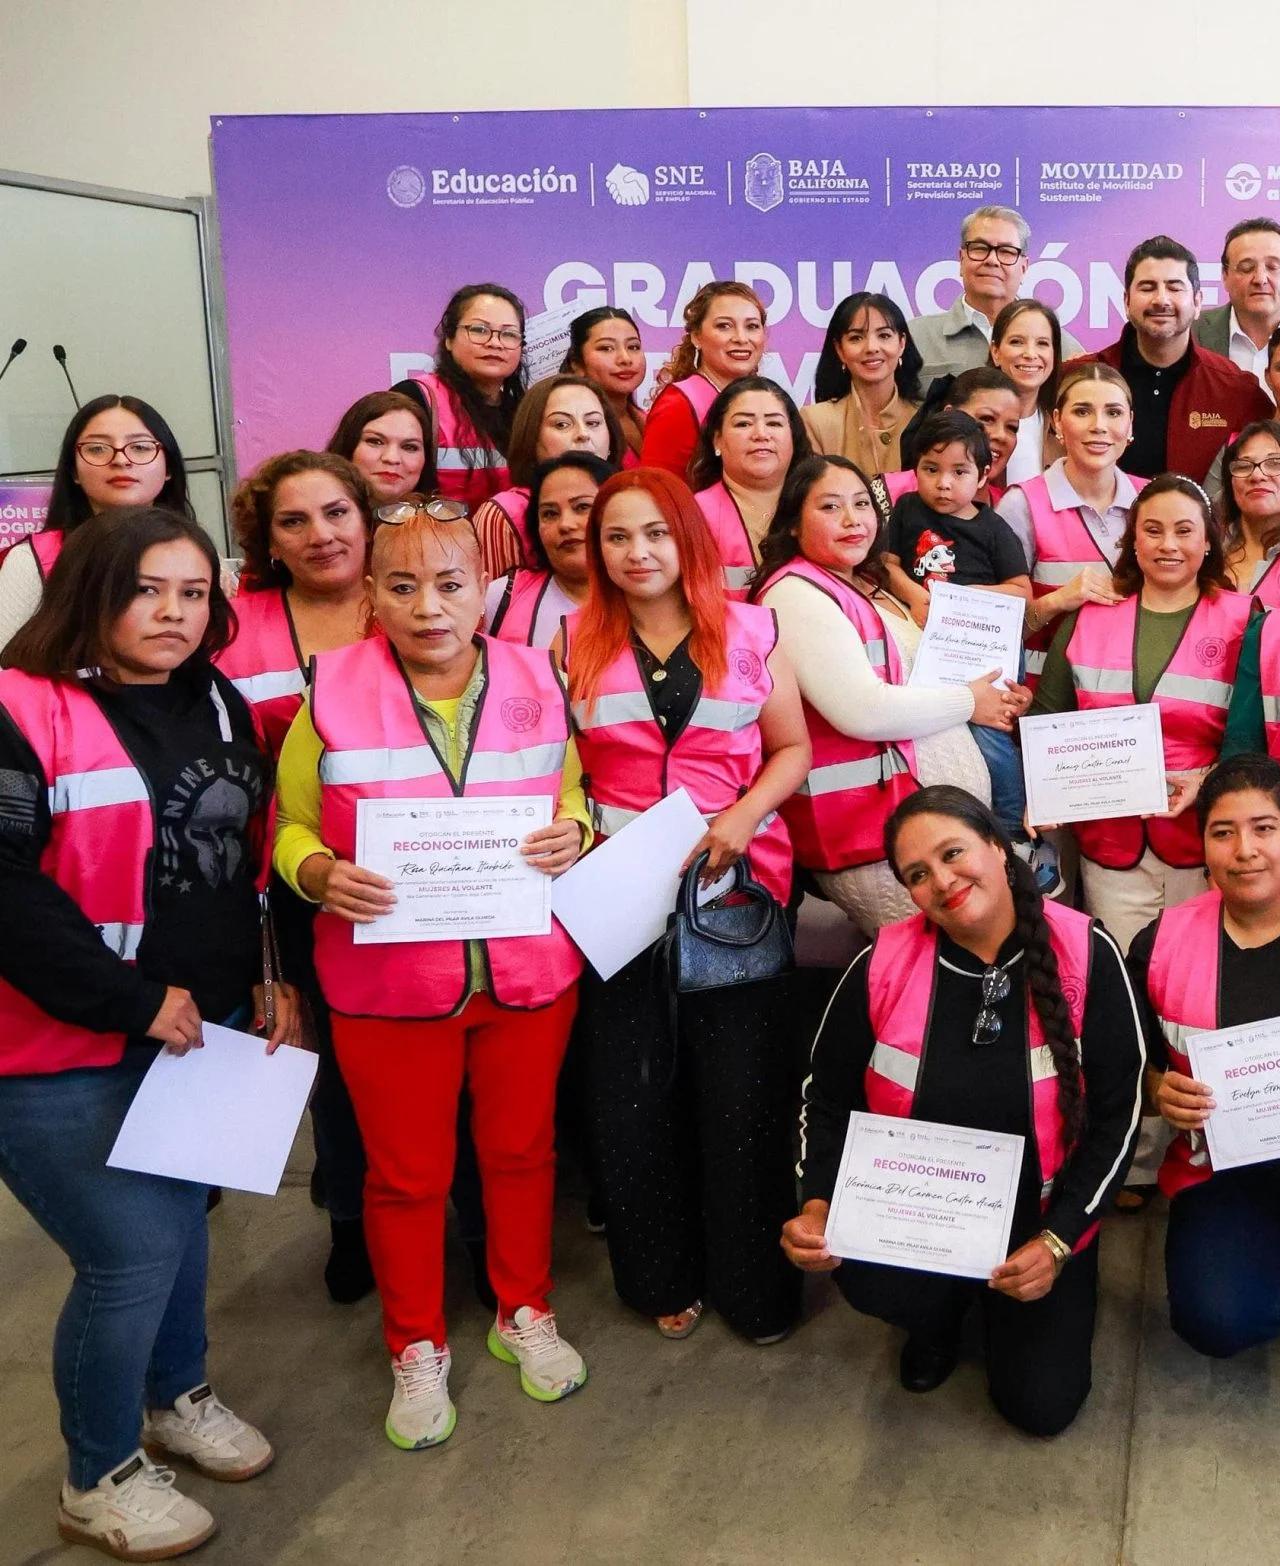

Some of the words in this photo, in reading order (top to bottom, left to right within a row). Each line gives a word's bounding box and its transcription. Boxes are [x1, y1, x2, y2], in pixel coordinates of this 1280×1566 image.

[655, 166, 704, 185] SNE
[789, 160, 846, 178] BAJA
[907, 163, 1001, 178] TRABAJO
[1041, 162, 1183, 180] MOVILIDAD
[432, 166, 577, 193] Educación
[789, 179, 869, 189] CALIFORNIA
[953, 180, 967, 189] del
[968, 181, 1002, 191] Trabajo
[1040, 181, 1084, 190] Instituto
[1086, 181, 1099, 190] de
[1103, 181, 1153, 191] Movilidad
[907, 192, 913, 200] y
[914, 190, 955, 199] Previsión
[957, 191, 983, 199] Social
[1040, 193, 1102, 202] Sustentable
[941, 616, 1000, 633] RECONOCIMIENTO
[1048, 738, 1136, 755] RECONOCIMIENTO
[163, 758, 215, 818] NINE
[394, 838, 518, 851] RECONOCIMIENTO
[873, 1158, 986, 1183] RECONOCIMIENTO
